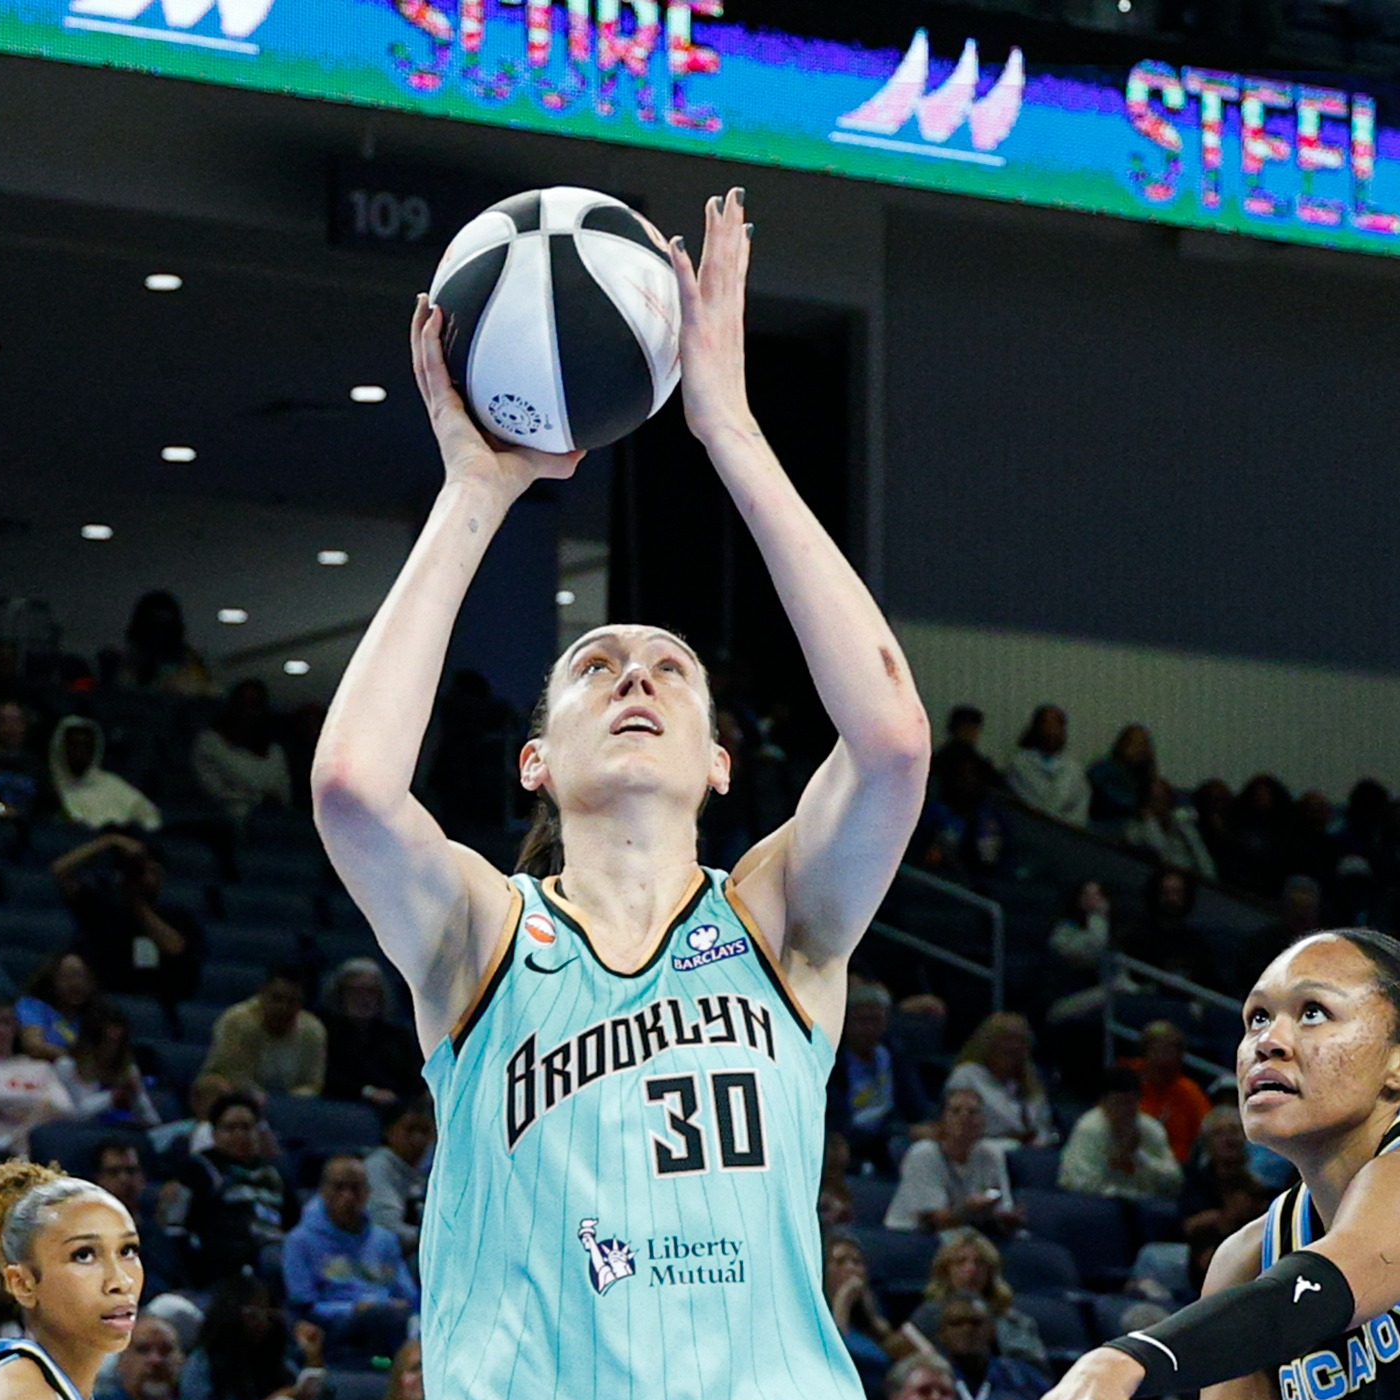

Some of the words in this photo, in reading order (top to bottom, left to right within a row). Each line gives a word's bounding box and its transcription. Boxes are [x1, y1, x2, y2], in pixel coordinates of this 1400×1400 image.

[348, 190, 430, 239] 109
[673, 940, 746, 970] BARCLAYS
[506, 994, 777, 1154] BROOKLYN
[643, 1068, 770, 1178] 30
[646, 1235, 744, 1265] Liberty
[648, 1262, 746, 1288] Mutual
